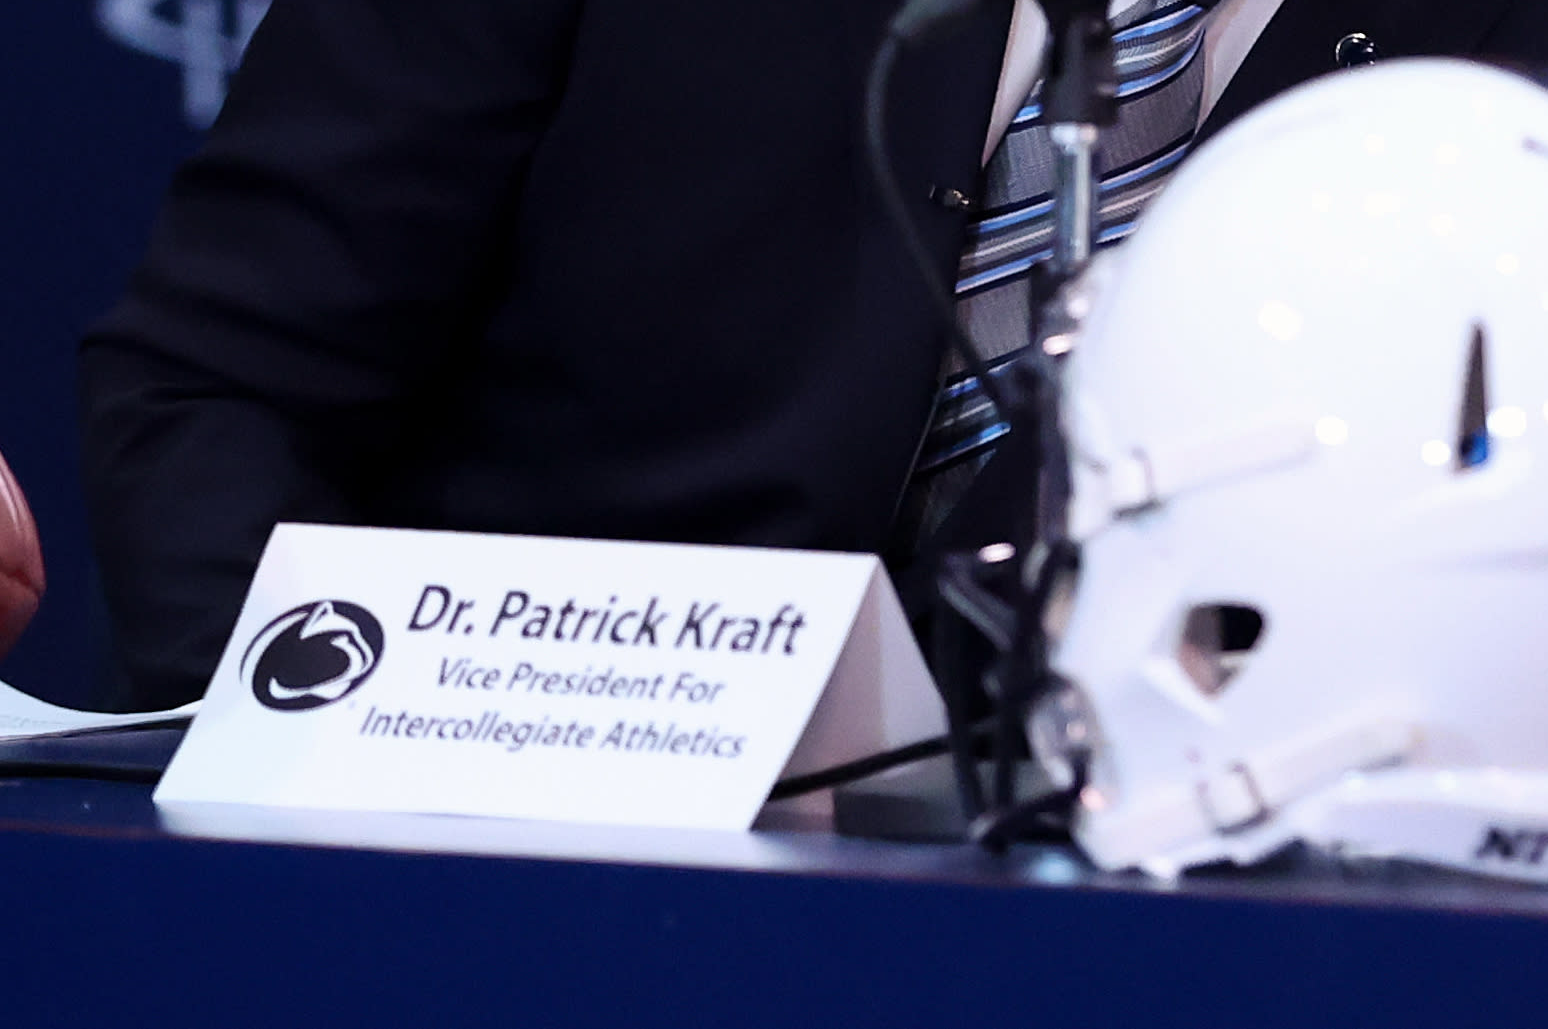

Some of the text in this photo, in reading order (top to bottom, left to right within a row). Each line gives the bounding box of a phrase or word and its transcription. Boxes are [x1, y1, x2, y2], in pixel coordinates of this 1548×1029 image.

[407, 584, 807, 656] Dr. Patrick Kraft
[437, 656, 726, 704] Vice President For
[359, 706, 747, 759] Intercollegiate Athletics
